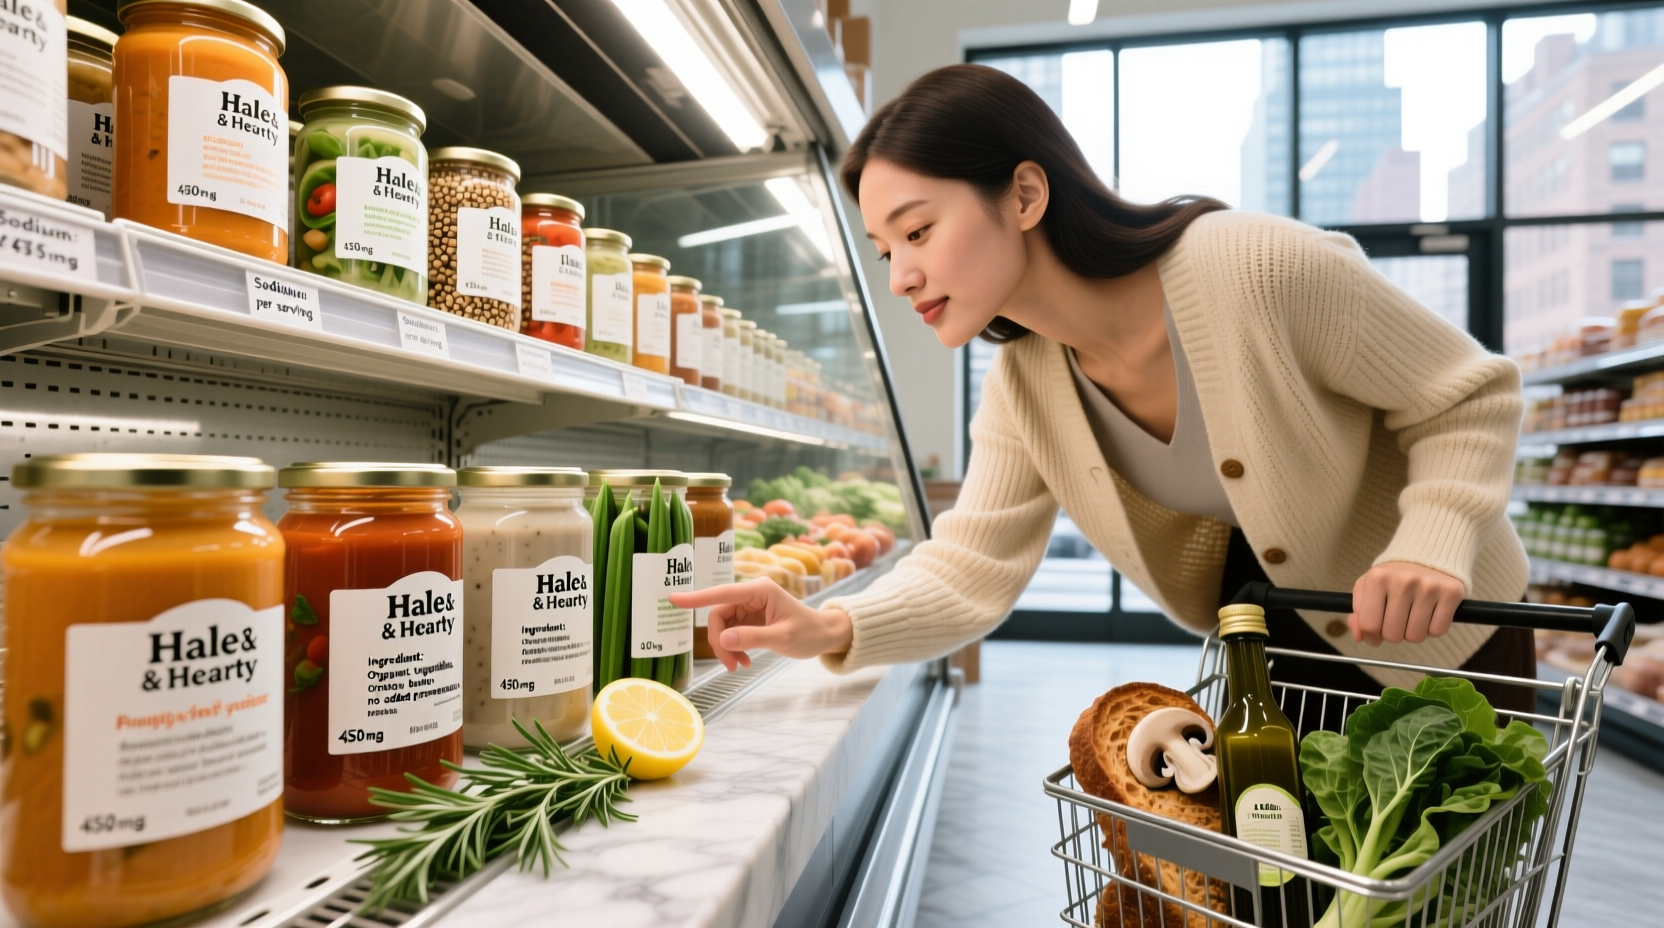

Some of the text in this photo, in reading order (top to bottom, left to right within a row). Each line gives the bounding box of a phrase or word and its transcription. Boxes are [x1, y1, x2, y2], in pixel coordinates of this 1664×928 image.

[217, 113, 228, 127] &
[256, 298, 273, 310] per
[386, 589, 455, 619] Hale&
[533, 596, 544, 610] &
[381, 616, 455, 640] & Hearty
[148, 625, 258, 663] Hale&
[141, 658, 258, 691] & Hearty
[338, 729, 384, 743] 450mg
